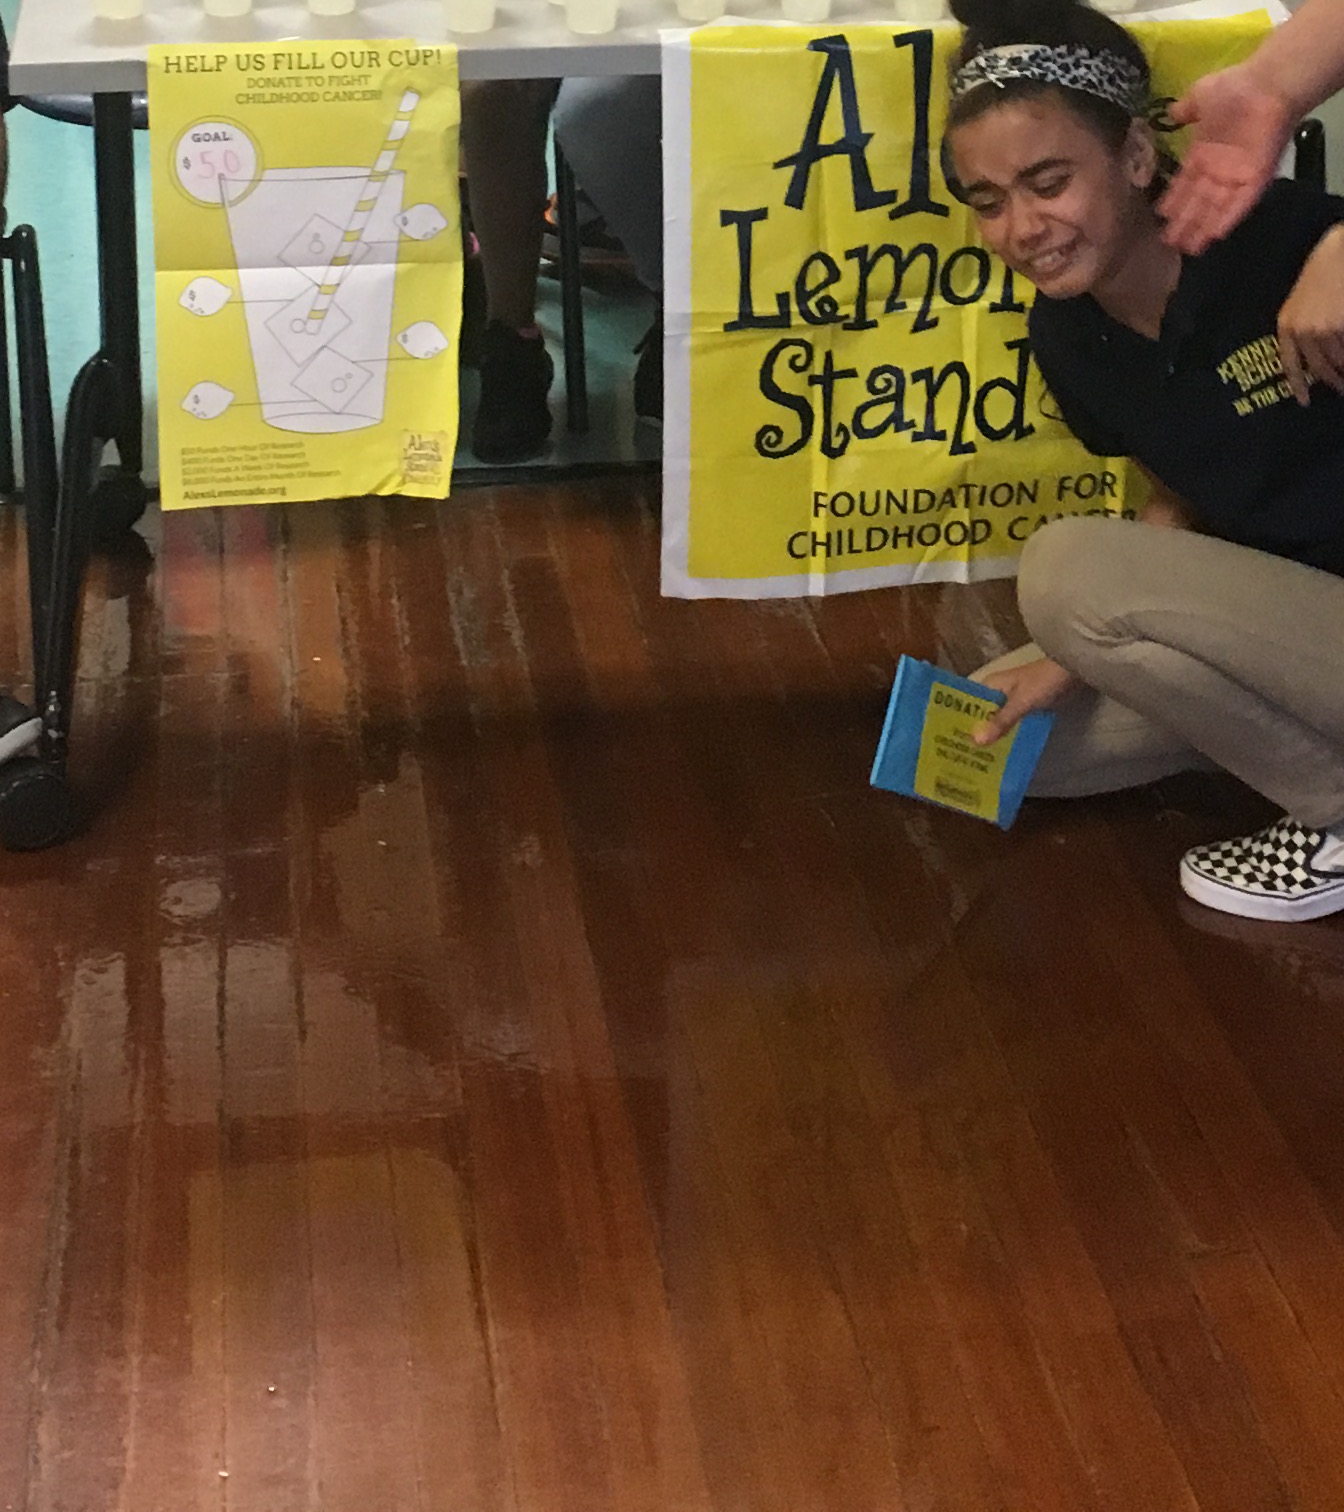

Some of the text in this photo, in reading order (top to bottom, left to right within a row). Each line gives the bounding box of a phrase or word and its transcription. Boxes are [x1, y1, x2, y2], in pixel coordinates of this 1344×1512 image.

[163, 49, 442, 74] HELP US FILL OUR CUP!
[246, 74, 372, 89] DONATE TO FIGHT
[235, 89, 383, 105] CHILDHOOD CANCER!
[197, 149, 241, 179] 50
[755, 338, 1035, 459] Stand
[813, 471, 1118, 519] FOUNDATION FOR
[786, 519, 993, 560] CHILDHOOD
